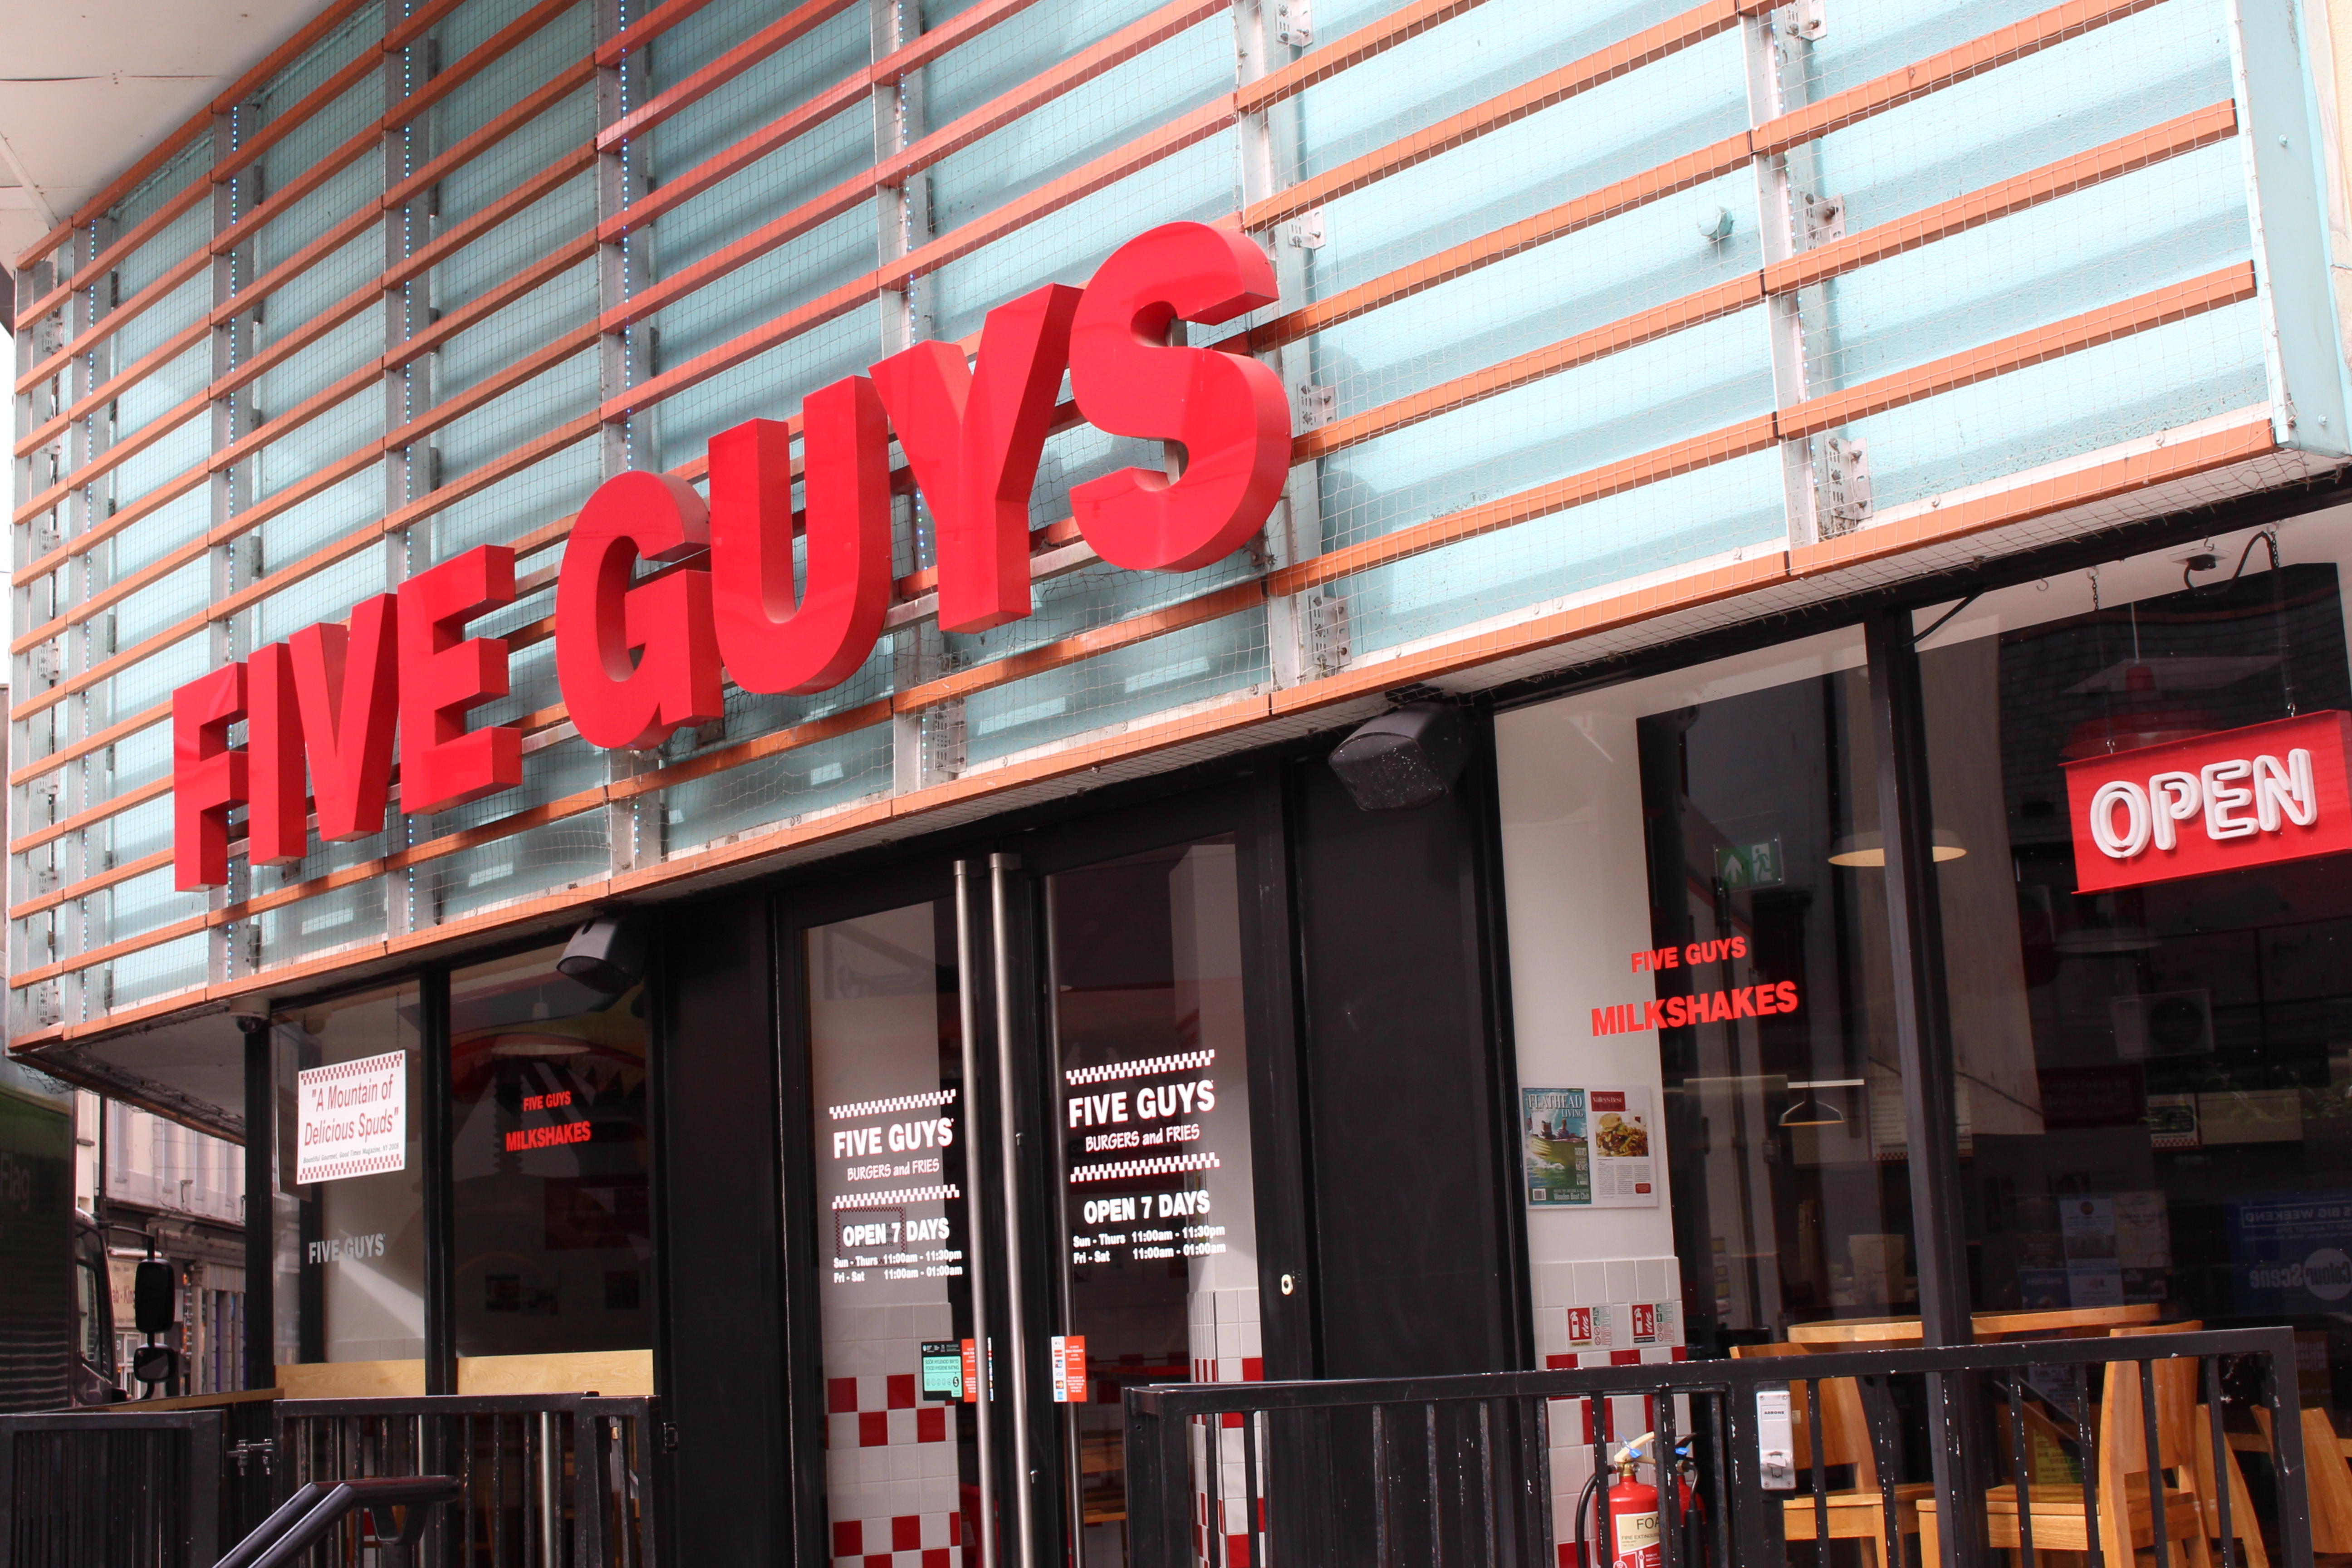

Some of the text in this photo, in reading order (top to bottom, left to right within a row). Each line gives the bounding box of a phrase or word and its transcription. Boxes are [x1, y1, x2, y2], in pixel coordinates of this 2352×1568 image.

[173, 221, 1292, 892] FIVE GUYS
[2090, 748, 2317, 858] OPEN
[1631, 936, 1747, 973] FIVE GUYS
[1591, 980, 1798, 1037] MILKSHAKES
[312, 1073, 393, 1112] "A Mountain of
[523, 1091, 571, 1112] FIVE GUYS
[1069, 1080, 1215, 1128] FIVE GUYS
[1527, 1094, 1583, 1109] FLATHEAD
[304, 1107, 398, 1146] Delicious Spuds"
[1562, 1109, 1584, 1118] LIVING
[505, 1120, 592, 1152] MILKSHAKES
[834, 1117, 953, 1158] FIVE GUYS
[1085, 1131, 1140, 1152] BURGERS
[1142, 1128, 1163, 1146] and
[1166, 1123, 1200, 1142] FRIES
[847, 1158, 940, 1181] BURGERS and FRIES
[1084, 1190, 1211, 1224] OPEN 7 DAYS
[843, 1223, 887, 1247] OPEN
[891, 1222, 901, 1243] 7
[906, 1217, 950, 1242] DAYS
[1073, 1235, 1091, 1248] Sun
[1098, 1233, 1126, 1245] Thurs
[1132, 1230, 1173, 1243] 11:00am
[1182, 1225, 1225, 1240] 11:30pm
[309, 1233, 385, 1264] FIVE GUYS
[833, 1257, 848, 1269] Sun
[855, 1255, 878, 1267] Thurs
[883, 1253, 918, 1264] 11:00am
[926, 1249, 962, 1263] 11:30pm
[1073, 1252, 1086, 1264] Fri
[1094, 1250, 1111, 1262] Sat
[1133, 1246, 1174, 1260] 11:00am
[1183, 1242, 1226, 1256] 01:00am
[834, 1272, 845, 1283] Fri
[851, 1271, 865, 1282] Sat
[884, 1268, 919, 1280] 11:00am
[926, 1265, 962, 1277] 01:00am
[954, 1377, 958, 1385] 5
[1637, 1516, 1659, 1529] FOA
